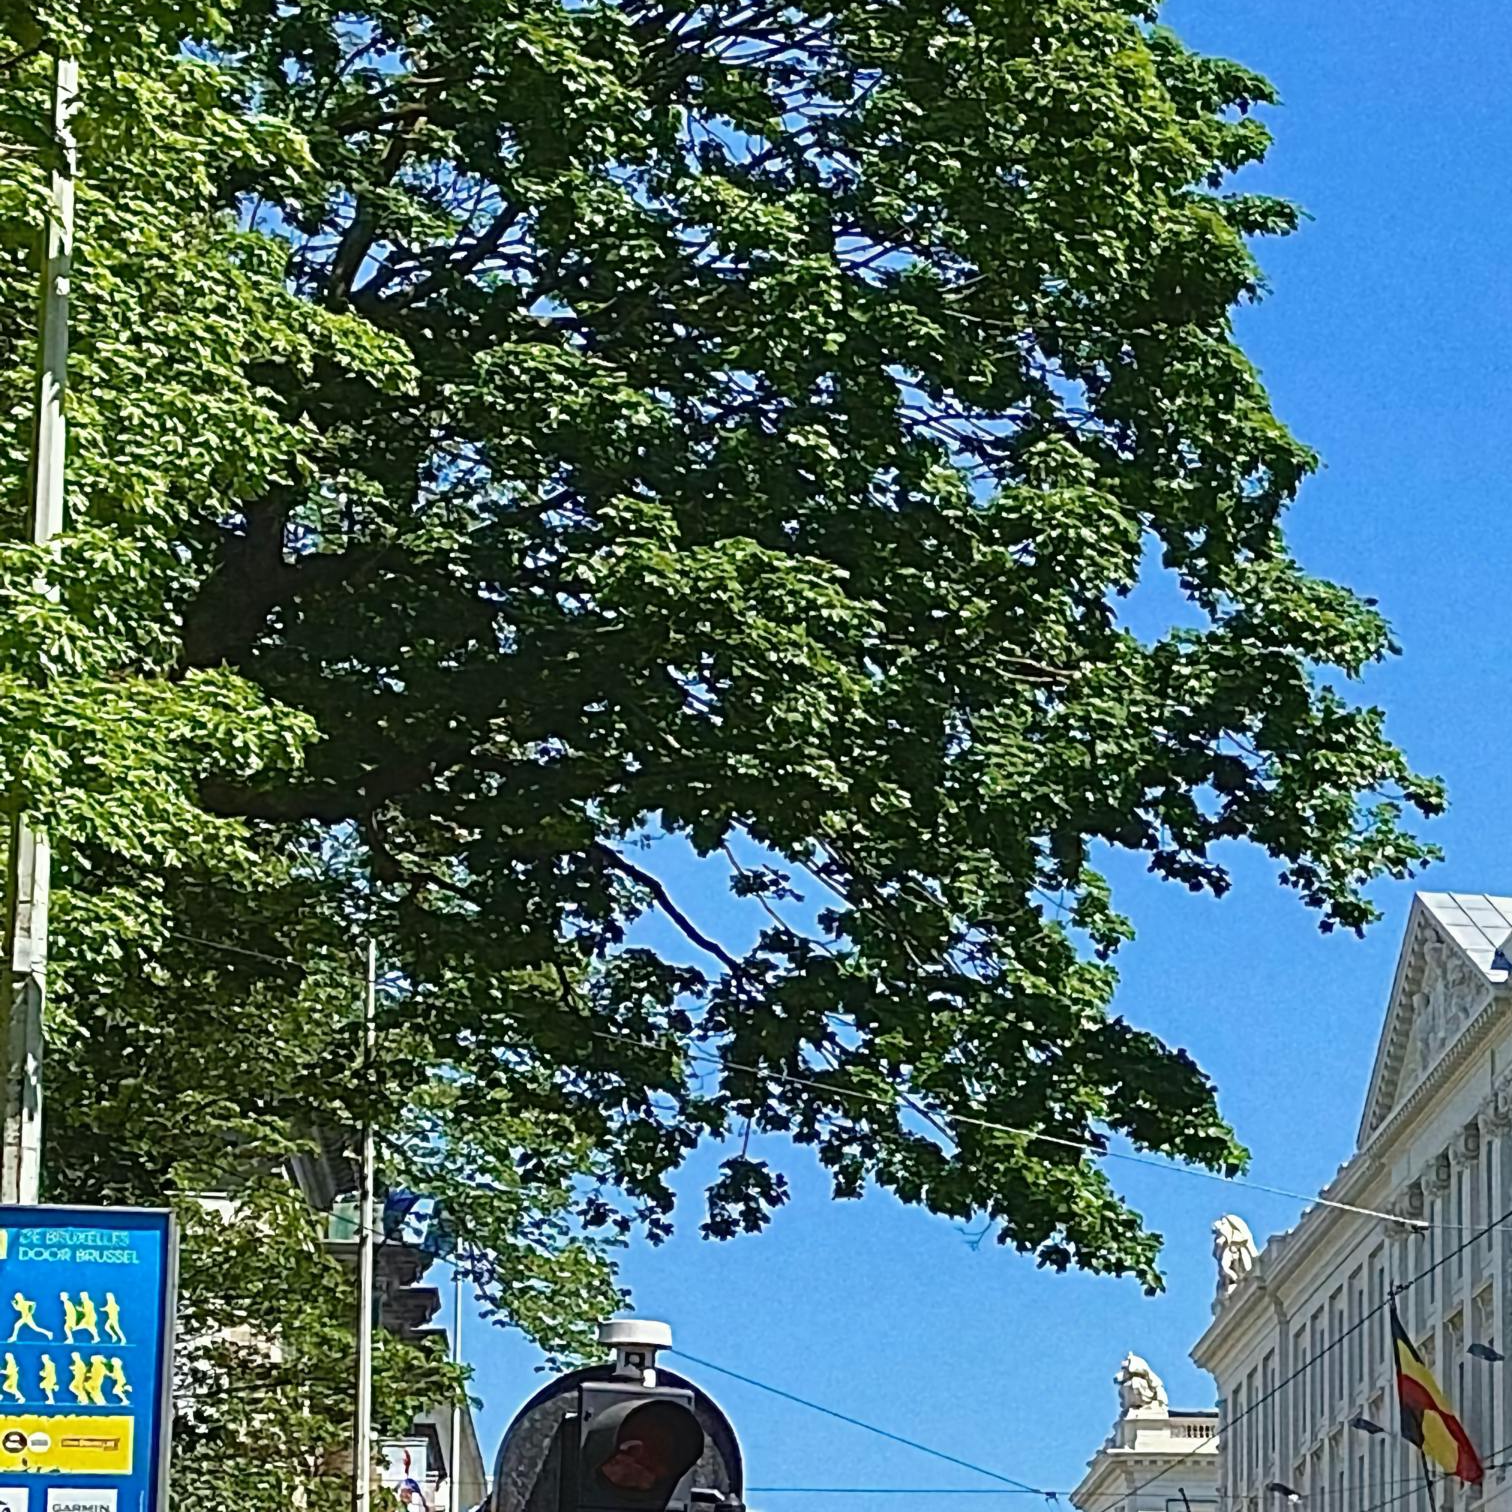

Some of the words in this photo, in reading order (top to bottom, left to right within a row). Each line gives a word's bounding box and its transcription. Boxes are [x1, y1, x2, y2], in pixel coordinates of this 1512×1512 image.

[46, 1229, 130, 1247] BRUXELLES
[18, 1247, 72, 1262] DOOR
[76, 1248, 140, 1265] BRUSSEL
